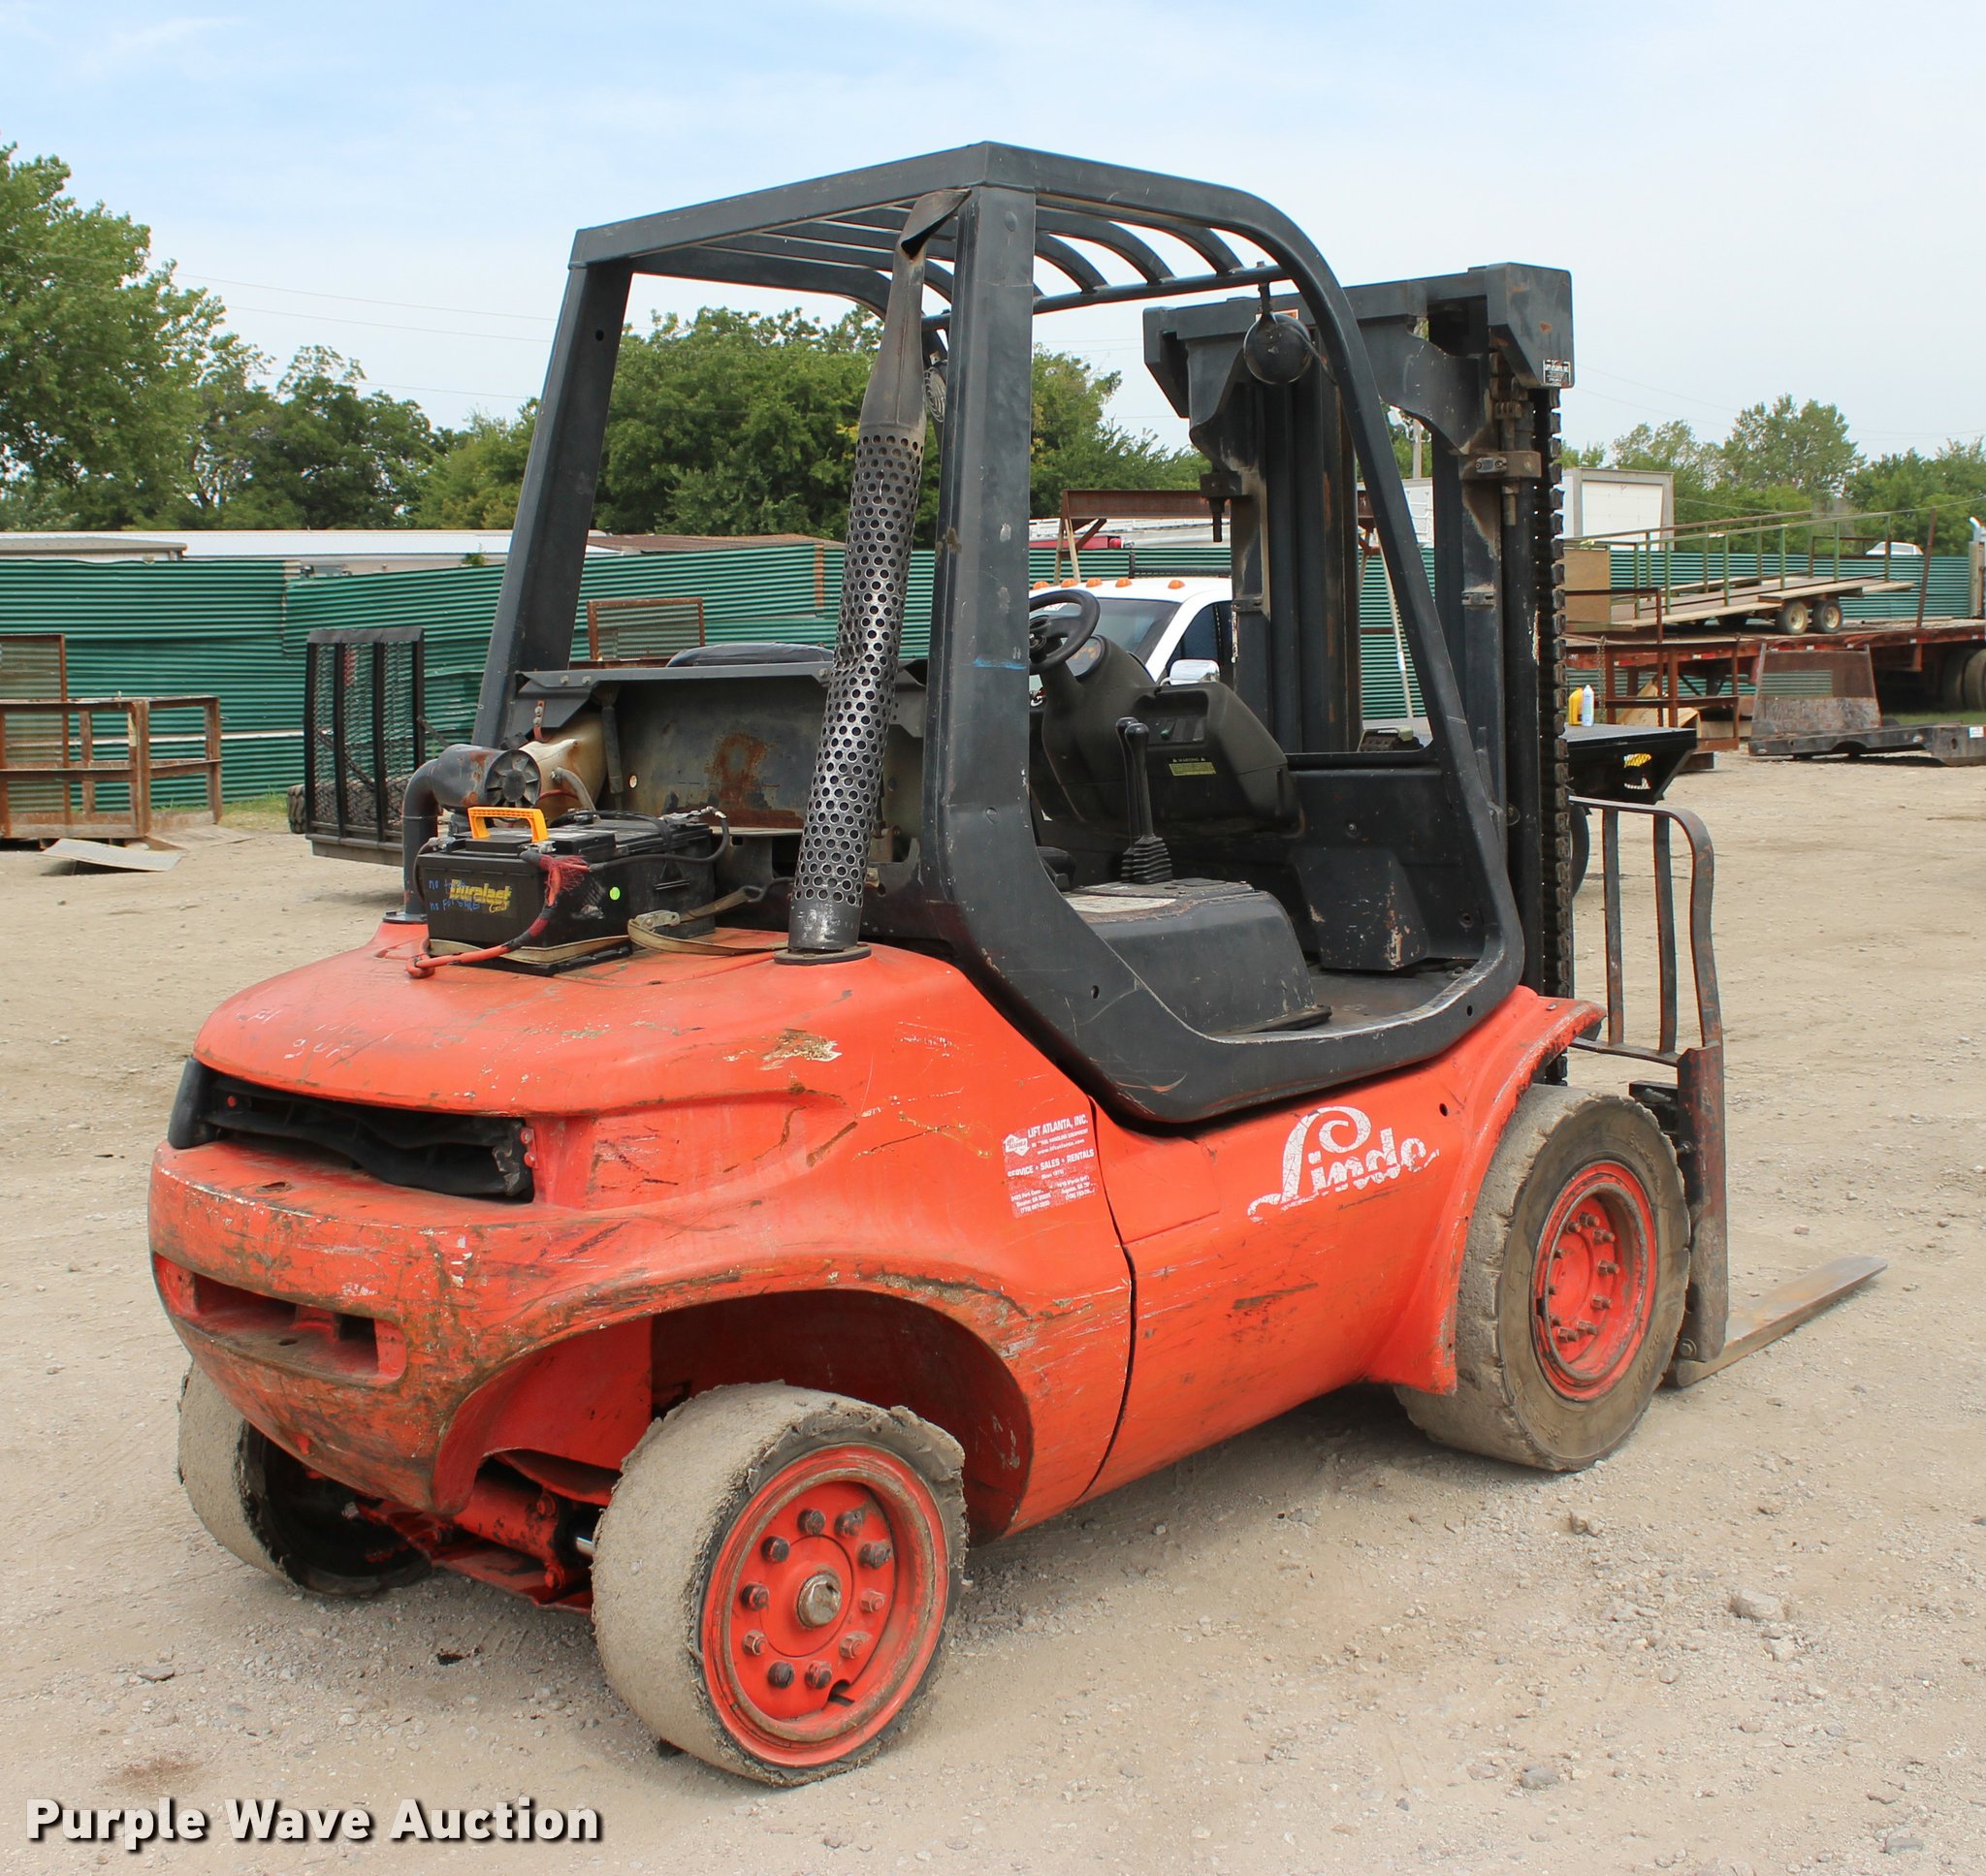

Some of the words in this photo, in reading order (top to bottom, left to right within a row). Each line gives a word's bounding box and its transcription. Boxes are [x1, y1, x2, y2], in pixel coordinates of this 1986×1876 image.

[1028, 1126, 1041, 1139] LIFT
[1041, 1118, 1073, 1135] ATLANTA,
[1073, 1114, 1089, 1127] INC.
[1040, 1157, 1061, 1171] SALES
[1067, 1148, 1095, 1162] RENTALS
[1247, 1105, 1440, 1224] Linde
